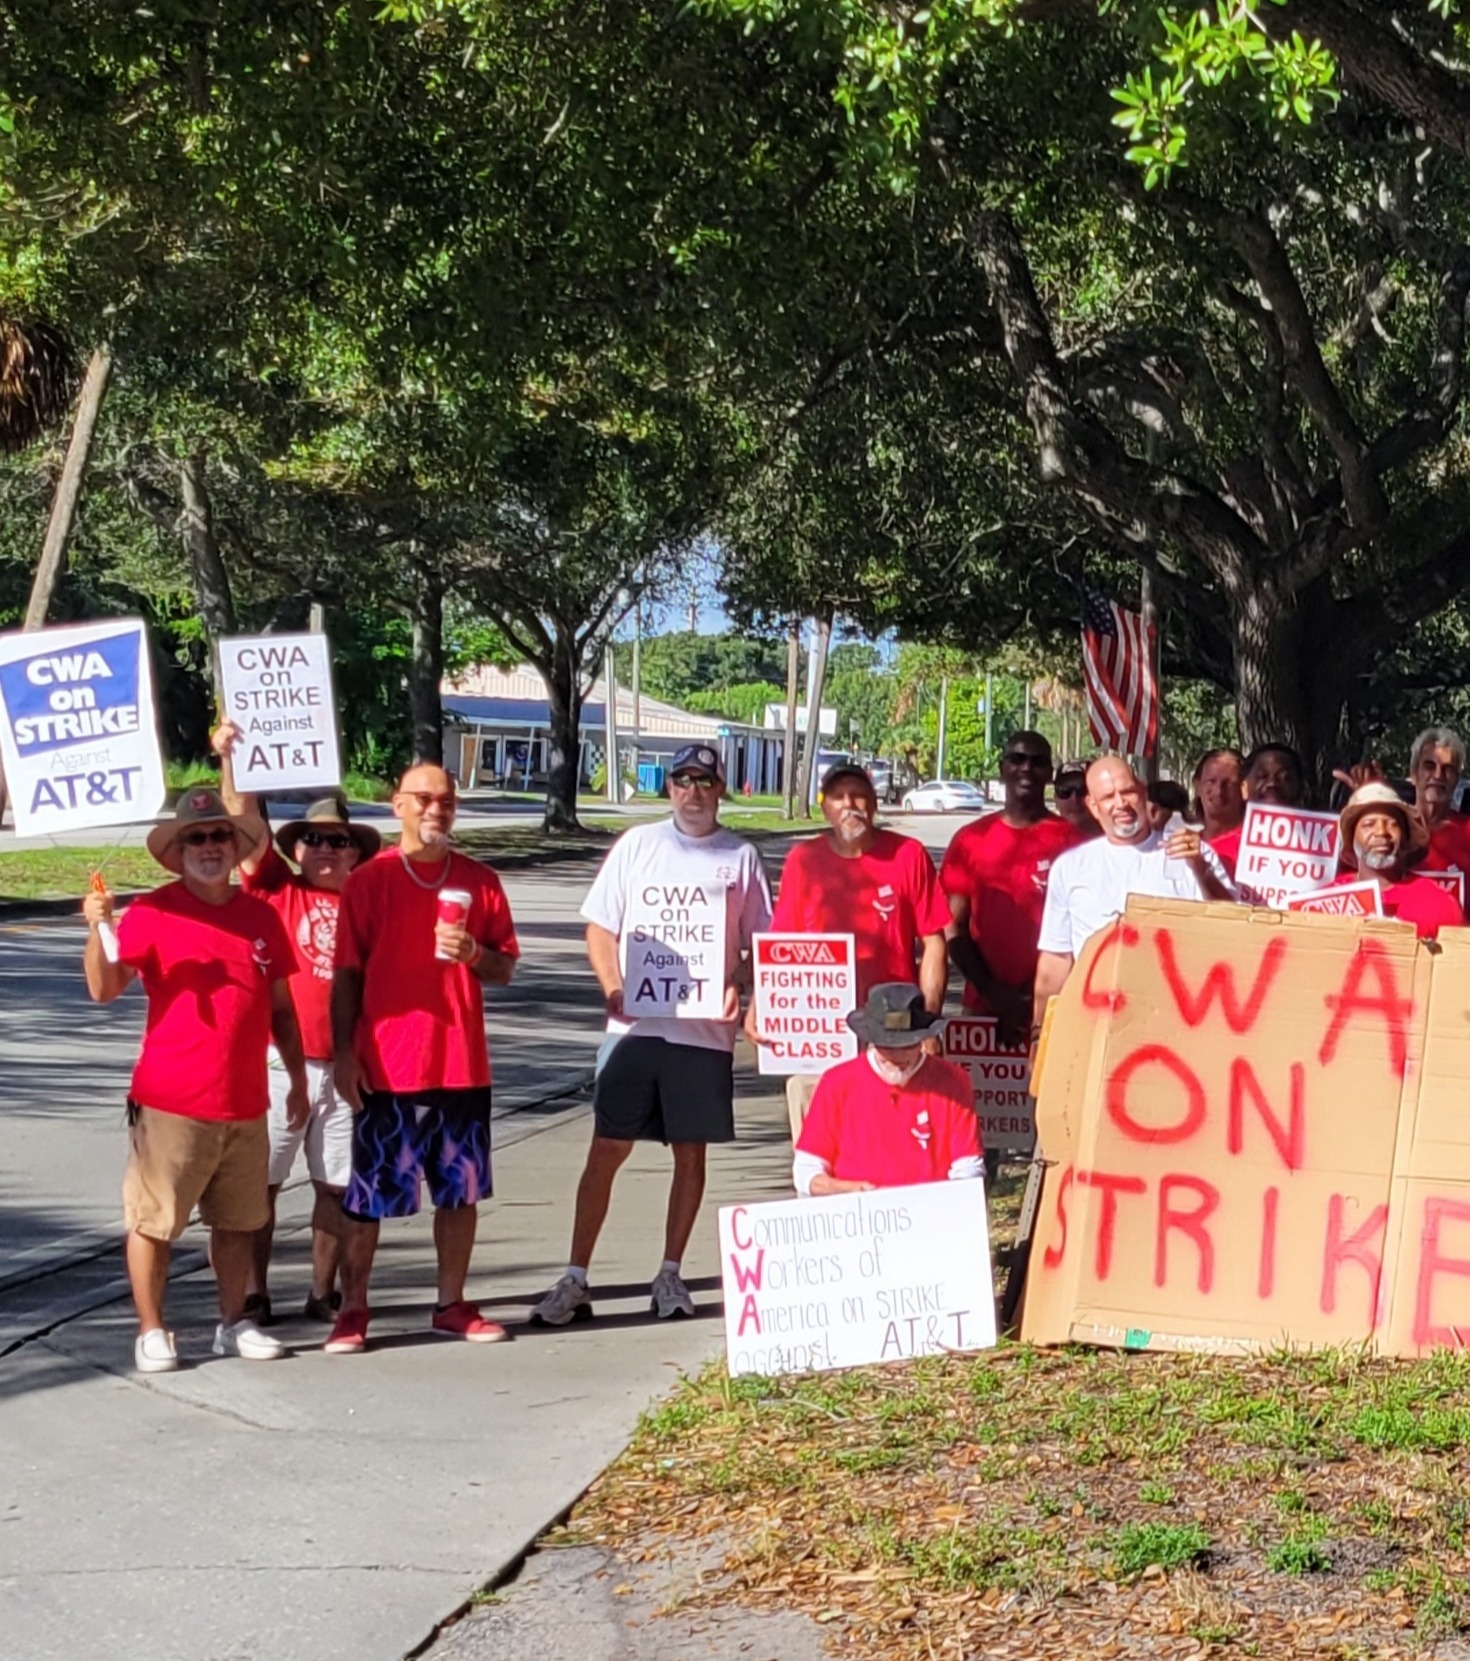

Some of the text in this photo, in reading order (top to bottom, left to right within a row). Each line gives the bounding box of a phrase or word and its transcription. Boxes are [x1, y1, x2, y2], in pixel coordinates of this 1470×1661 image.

[27, 653, 113, 685] CWA
[237, 646, 310, 670] CWA
[259, 671, 292, 686] on
[49, 686, 95, 711] on
[234, 687, 321, 710] STRIKE
[15, 705, 139, 745] STRIKE
[249, 715, 314, 736] Against
[51, 748, 112, 772] Against
[247, 740, 324, 772] AT&T
[30, 766, 142, 814] AT&T
[1249, 813, 1334, 852] HONK
[1249, 855, 1326, 881] IF YOU
[642, 886, 708, 906] CWA
[660, 907, 689, 922] on
[633, 924, 714, 943] STRIKE
[643, 950, 704, 970] Against
[770, 942, 836, 963] CWA
[635, 977, 710, 1002] AT&T
[760, 971, 847, 988] FIGHTING
[769, 993, 840, 1009] for the
[1083, 923, 1414, 1077] CWA
[765, 1017, 847, 1034] MIDDLE
[772, 1041, 842, 1058] CLASS
[979, 1063, 1025, 1080] YOU
[974, 1089, 1028, 1106] PPORT
[1106, 1043, 1306, 1170] ON
[731, 1196, 912, 1250] Communications
[730, 1235, 884, 1293] Workers of
[737, 1282, 948, 1337] America on STRIKE
[880, 1310, 970, 1359] AT&T
